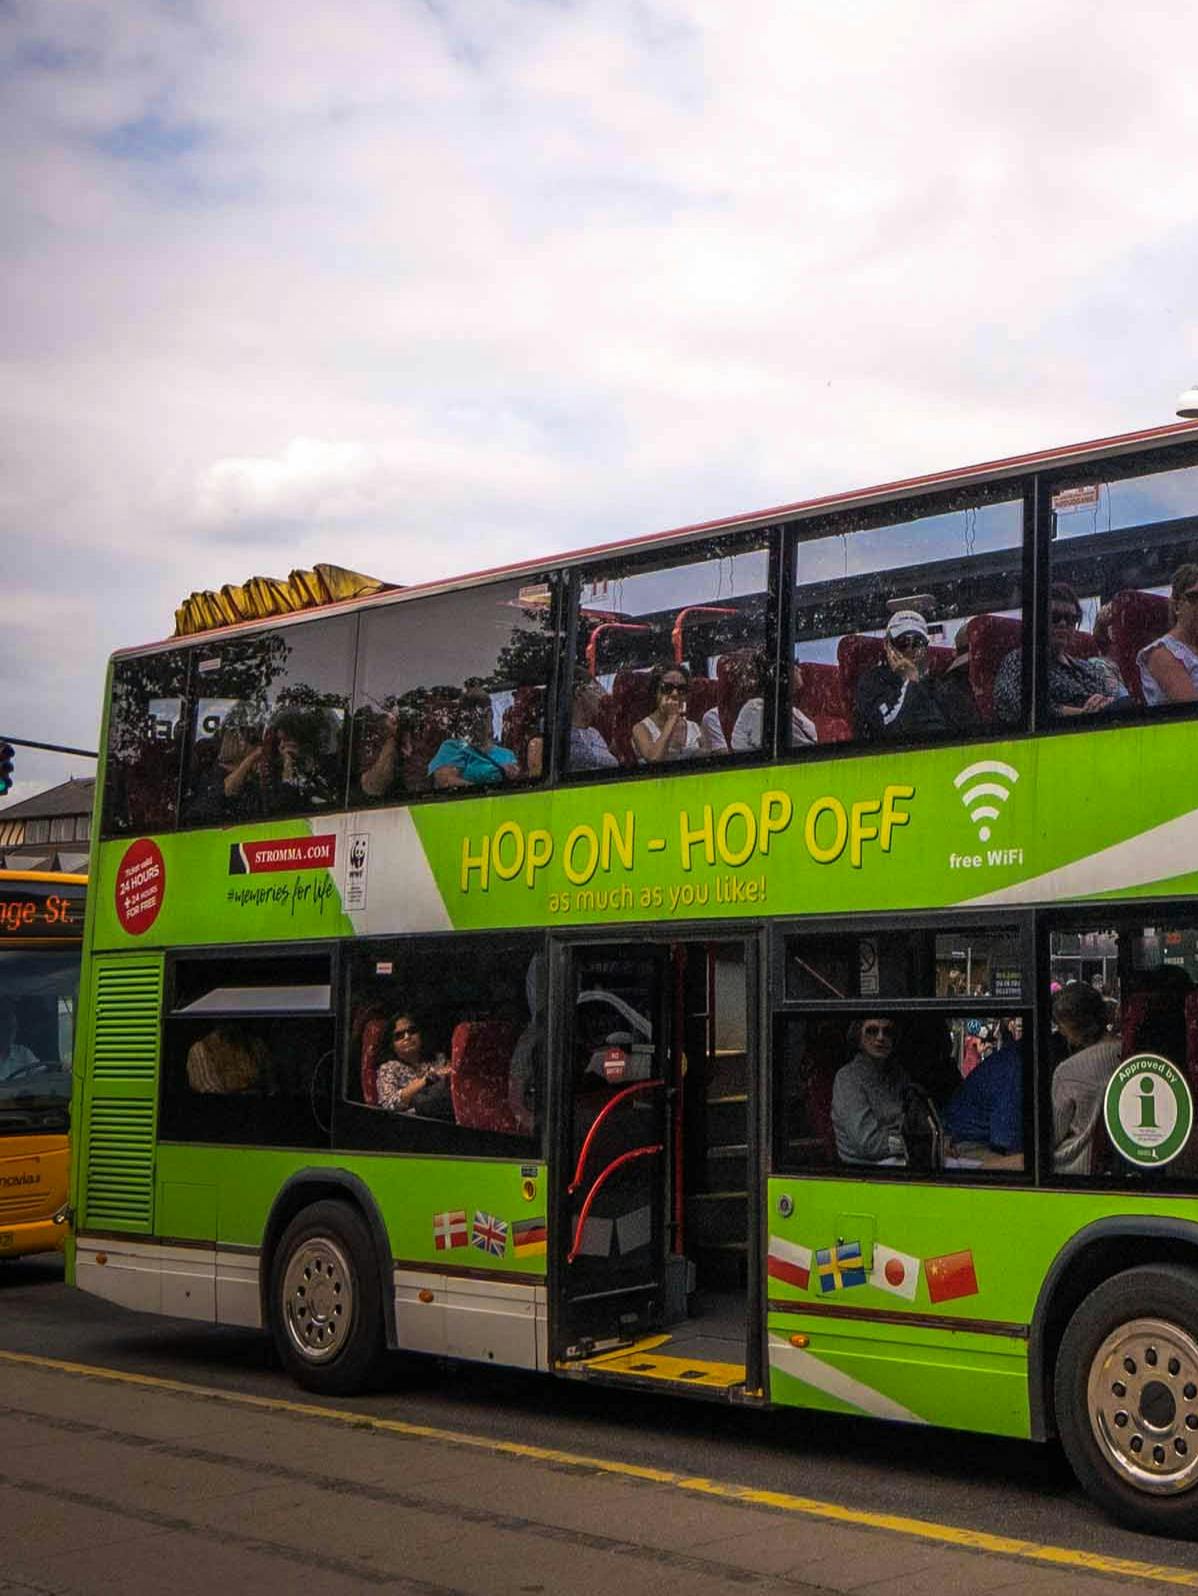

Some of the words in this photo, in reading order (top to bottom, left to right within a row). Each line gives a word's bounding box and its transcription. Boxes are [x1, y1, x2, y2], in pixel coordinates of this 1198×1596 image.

[460, 821, 553, 893] HOP
[563, 810, 635, 885] ON
[679, 790, 793, 871] HOP
[804, 784, 916, 869] OFF
[255, 845, 330, 863] STROMMA.COM
[949, 853, 983, 869] free
[987, 848, 1025, 867] WiFi
[131, 864, 160, 889] HOURS
[291, 876, 312, 916] for
[313, 873, 333, 915] life
[549, 892, 571, 913] as
[576, 884, 633, 911] much
[639, 887, 663, 908] as
[668, 880, 708, 914] you
[716, 875, 768, 903] like!
[44, 895, 74, 924] St.
[126, 905, 140, 920] FOR
[141, 896, 157, 912] FREE
[1119, 1060, 1165, 1082] Approved
[1165, 1069, 1178, 1083] by
